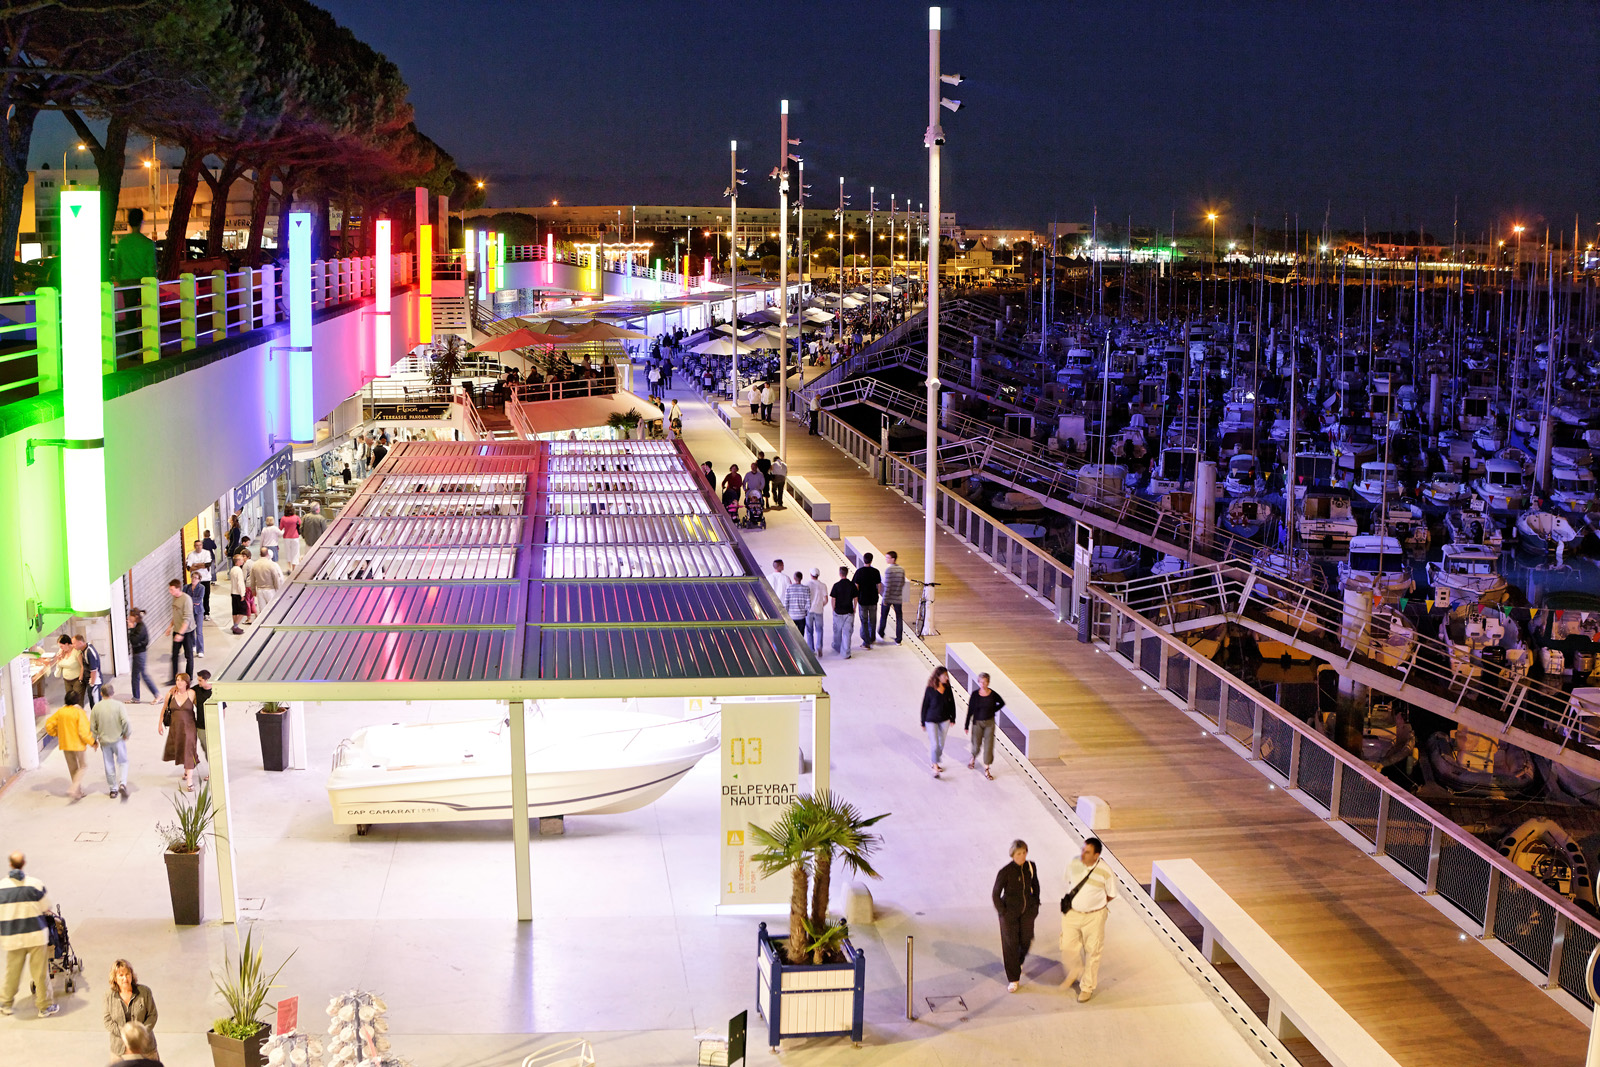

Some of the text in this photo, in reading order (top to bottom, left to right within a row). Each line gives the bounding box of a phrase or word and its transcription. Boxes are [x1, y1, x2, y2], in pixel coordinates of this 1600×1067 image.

[245, 482, 252, 500] LA
[730, 737, 762, 765] 03
[722, 783, 797, 796] DELPEYRAT
[730, 794, 797, 806] NAUTIQUE
